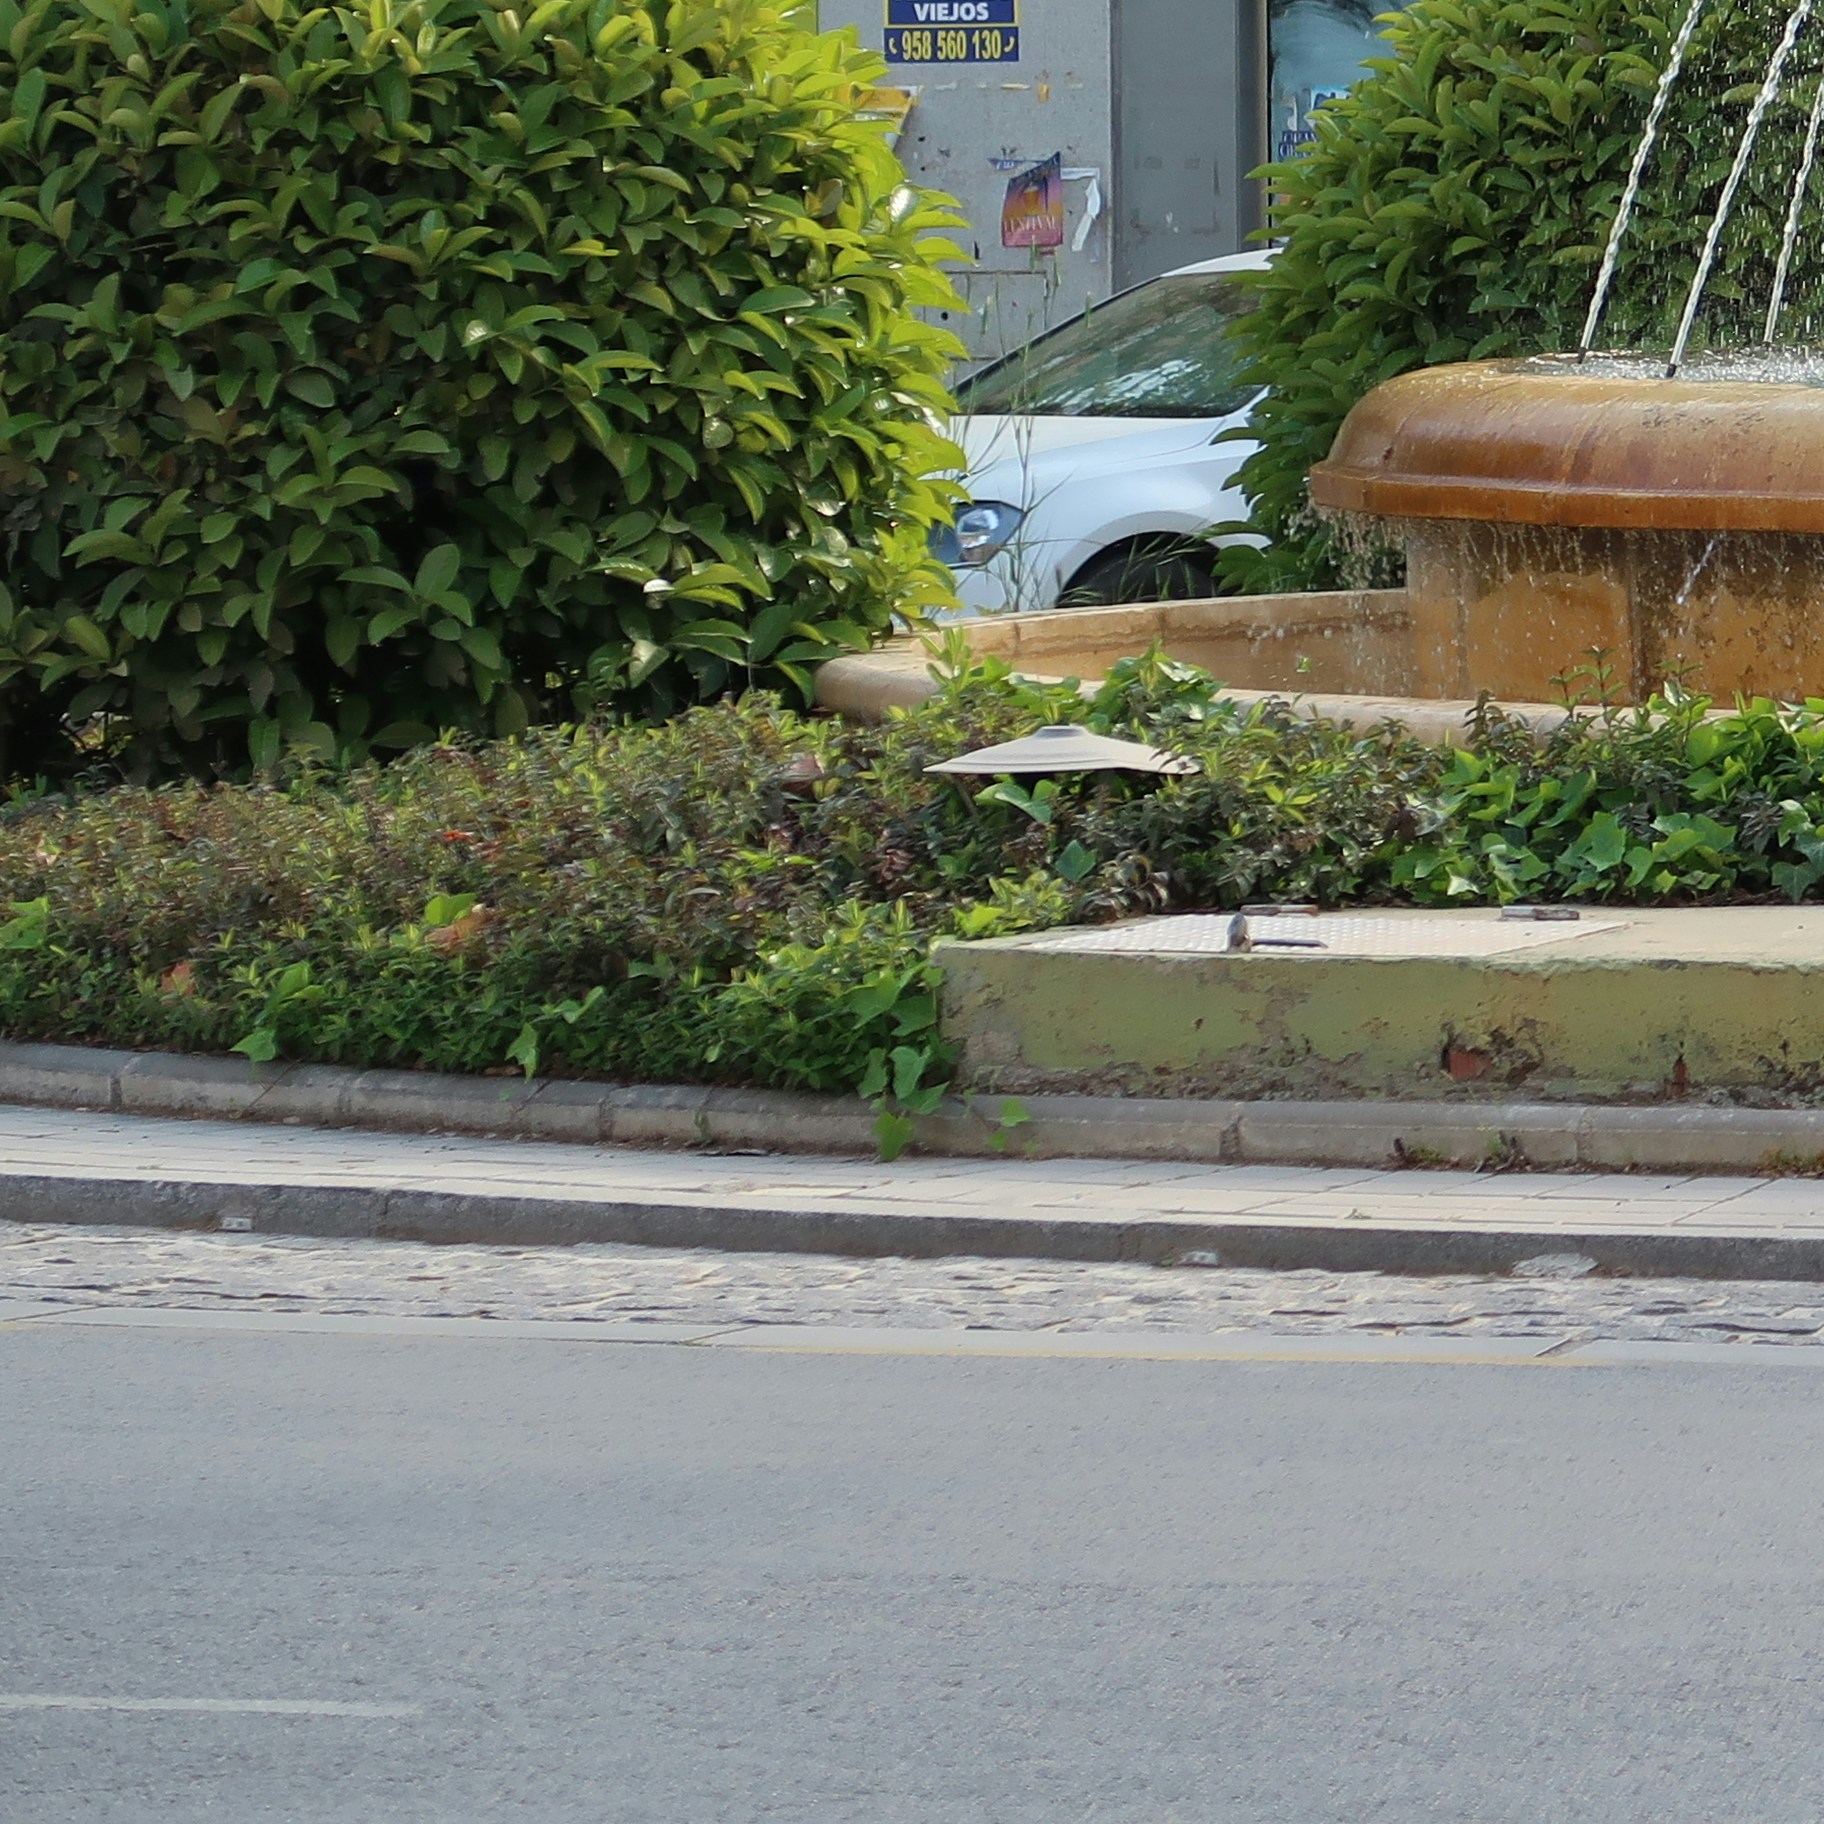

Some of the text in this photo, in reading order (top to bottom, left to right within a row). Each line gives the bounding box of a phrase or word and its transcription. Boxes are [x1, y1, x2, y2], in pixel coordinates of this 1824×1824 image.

[914, 2, 989, 21] VIEJOS
[902, 29, 1002, 61] 958 560 130
